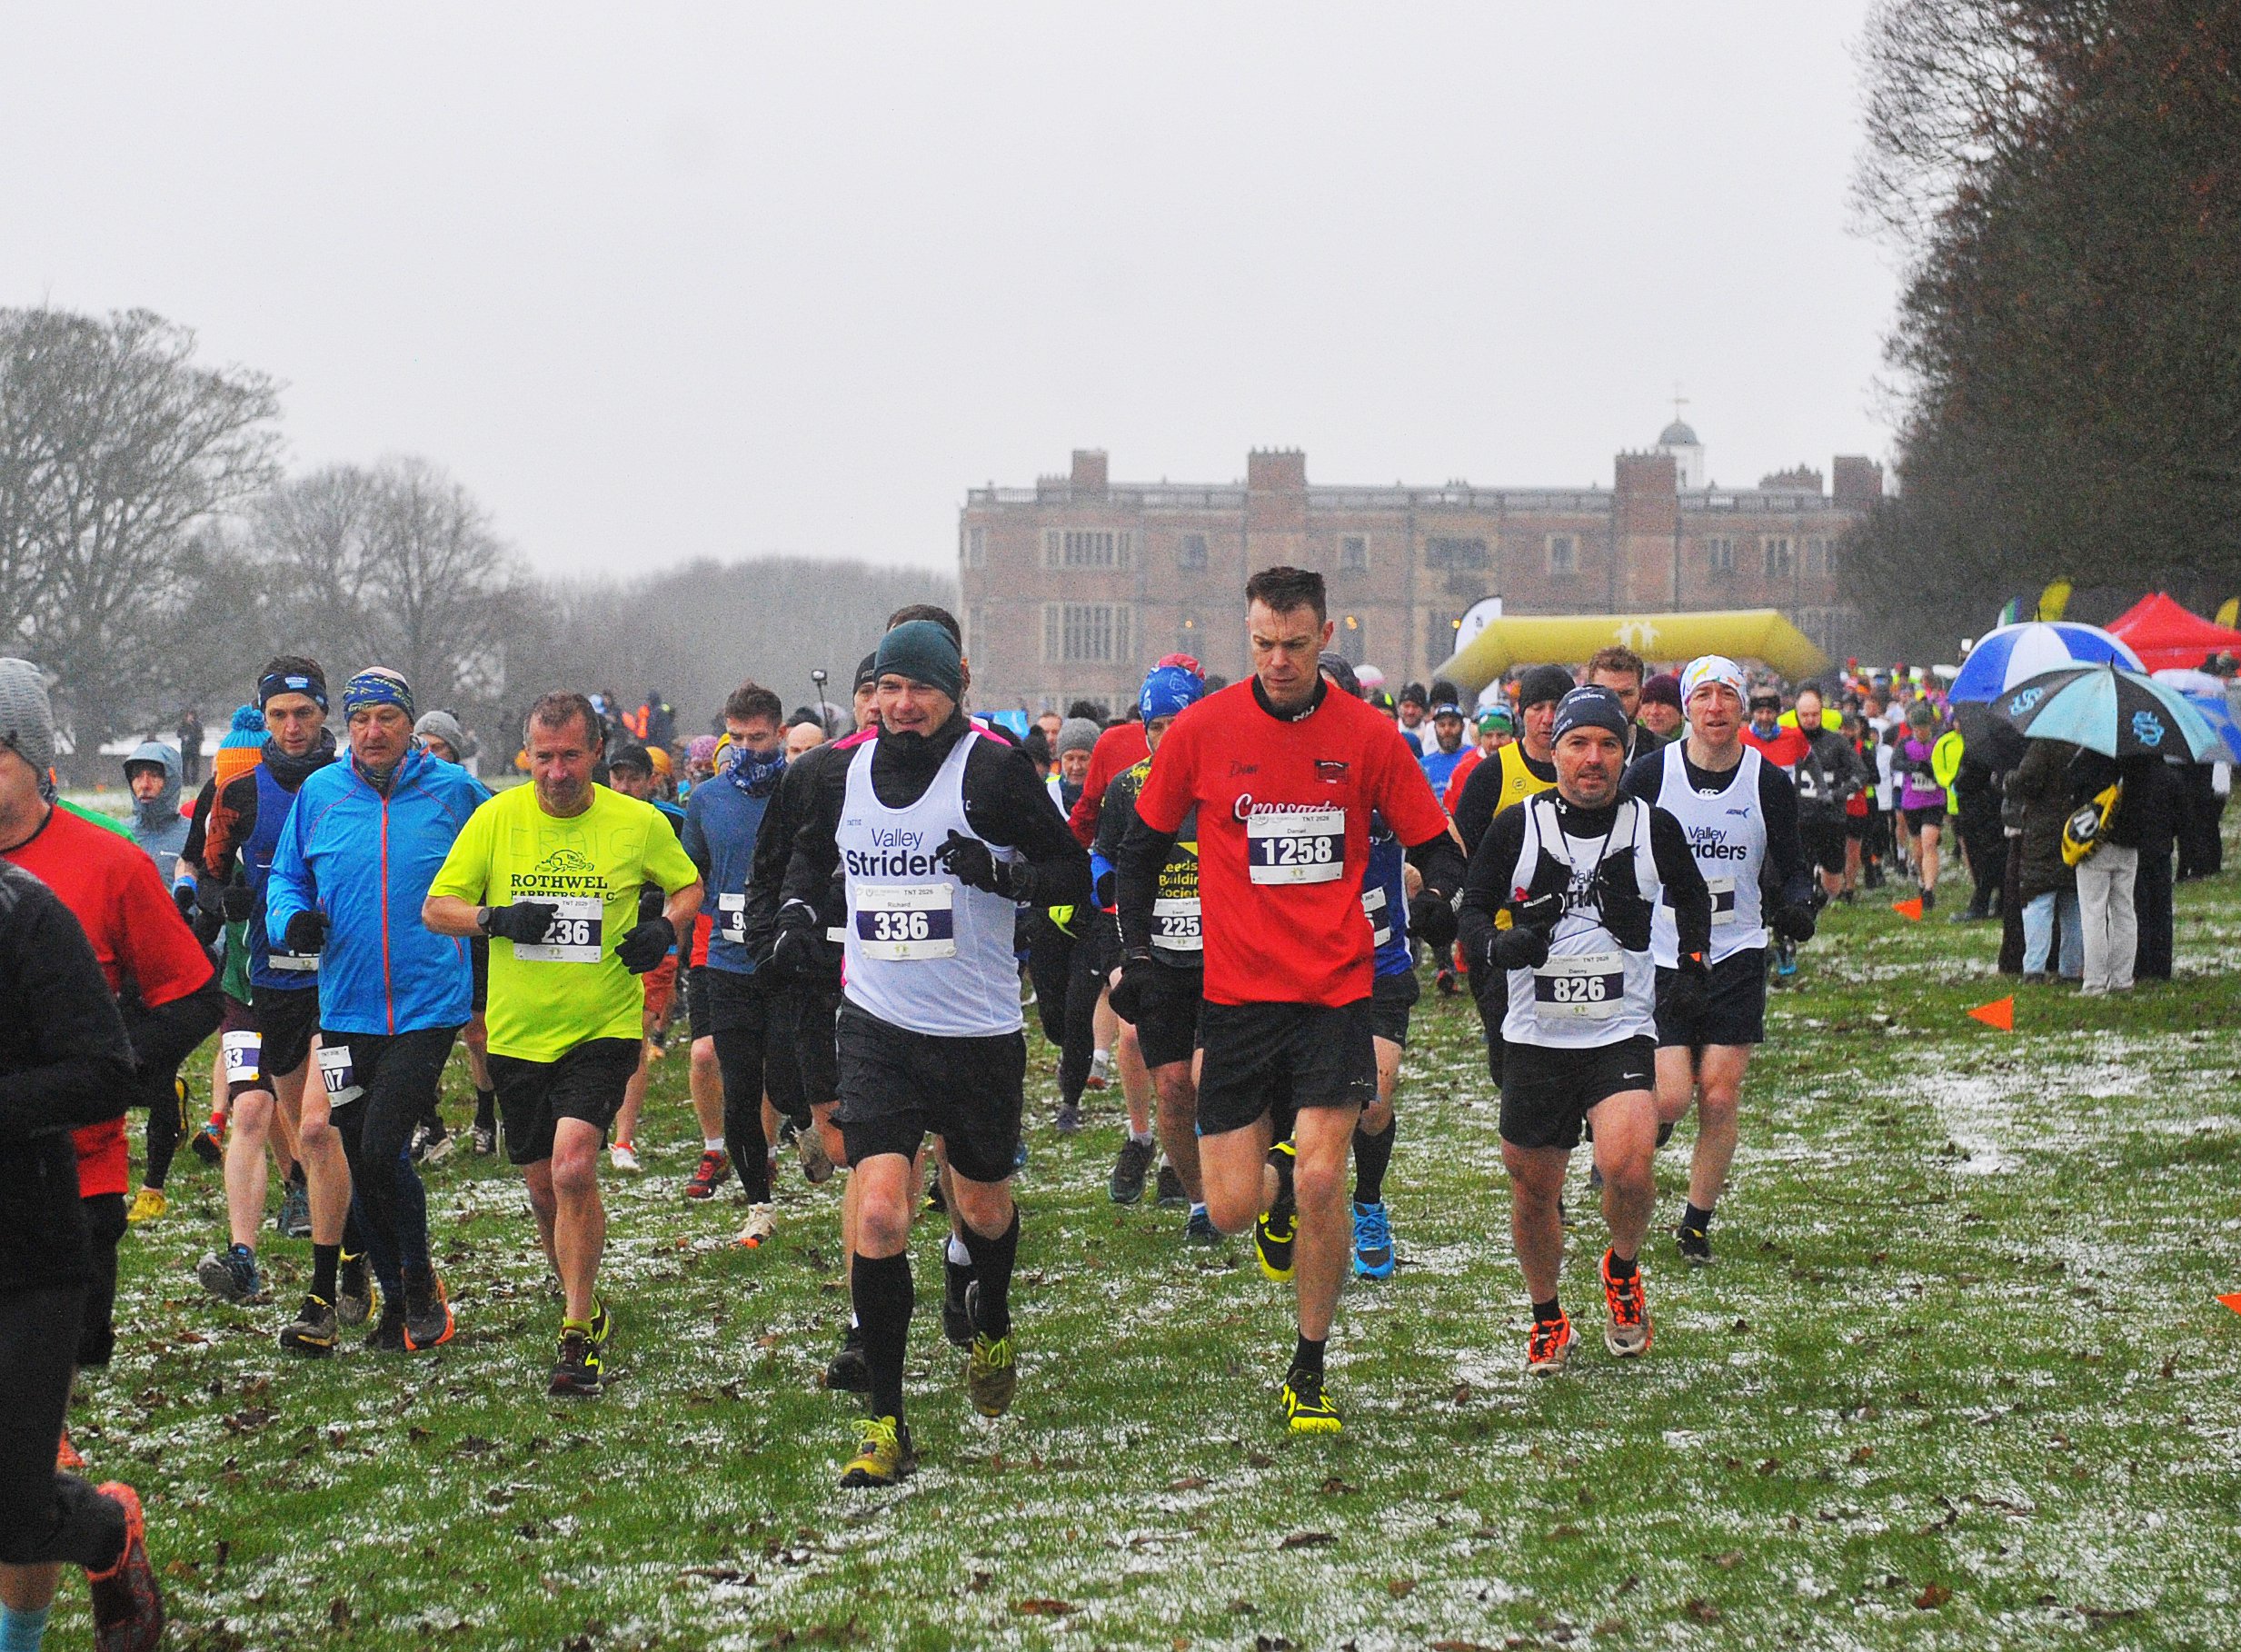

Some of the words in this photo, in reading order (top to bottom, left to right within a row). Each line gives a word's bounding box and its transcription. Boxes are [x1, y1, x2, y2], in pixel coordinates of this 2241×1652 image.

[872, 829, 923, 851] Valley
[1688, 826, 1727, 843] Valley
[1261, 836, 1332, 865] 1258
[1688, 840, 1747, 861] riders
[511, 874, 607, 890] ROTHWEL
[541, 920, 590, 945] 236
[874, 911, 929, 940] 336
[1160, 916, 1200, 936] 225
[1553, 976, 1606, 1002] 826
